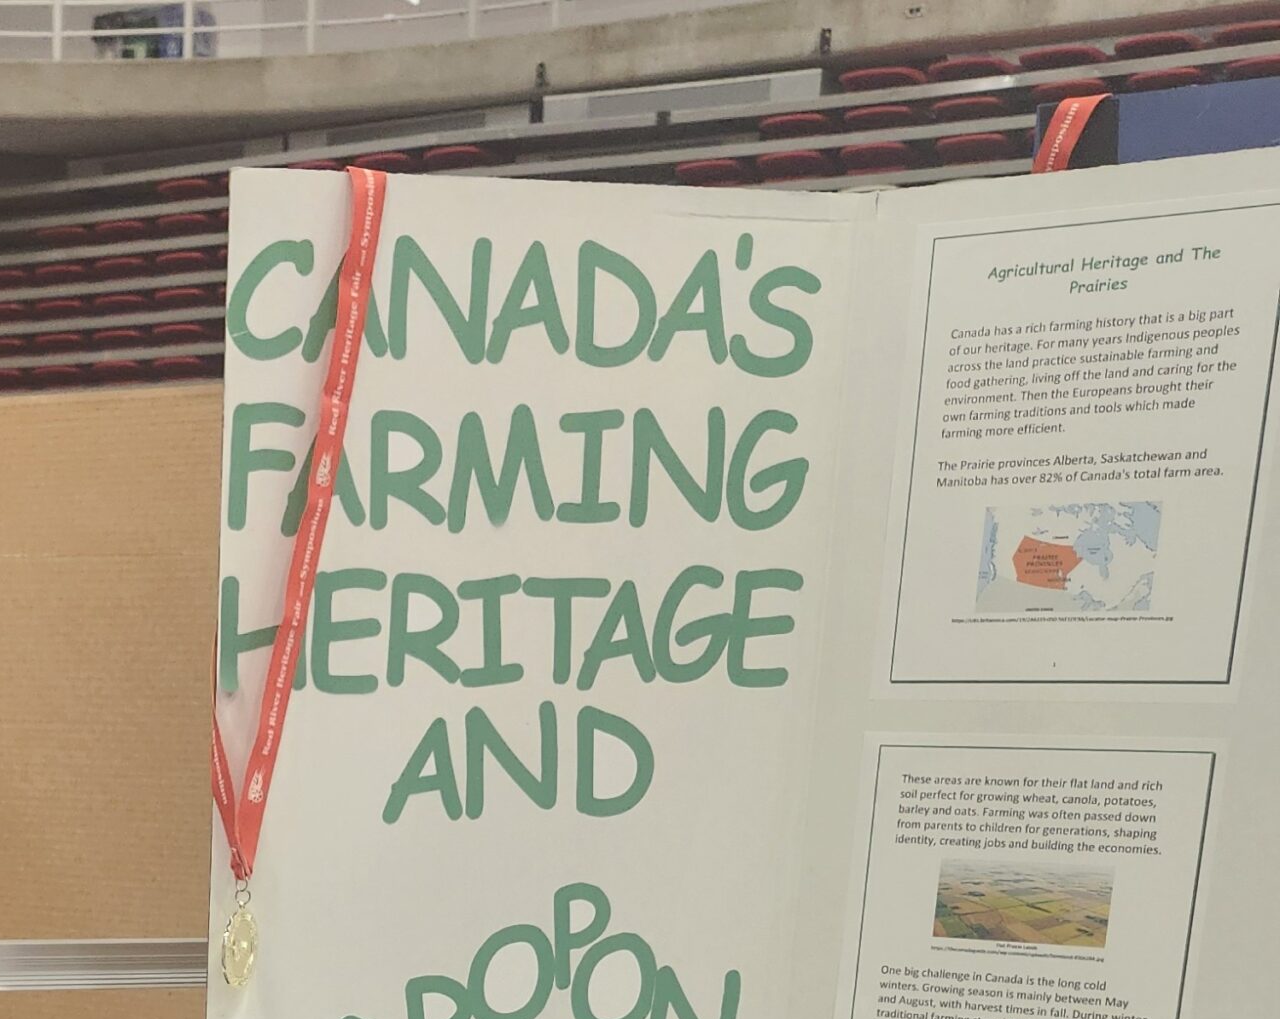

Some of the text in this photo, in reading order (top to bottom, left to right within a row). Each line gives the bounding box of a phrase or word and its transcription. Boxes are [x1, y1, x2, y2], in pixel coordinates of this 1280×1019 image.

[1044, 102, 1080, 172] ymposium
[987, 244, 1223, 282] Agricultural Heritage and The
[351, 271, 362, 298] Fair
[1069, 278, 1128, 294] Prairies
[226, 232, 821, 377] CANADA'S
[341, 301, 358, 364] Heritage
[332, 368, 347, 404] River
[944, 378, 1214, 406] environment. Then the Europeans brought their
[328, 406, 340, 436] Red
[227, 402, 809, 533] FARMING
[937, 447, 1208, 471] The Prairie provinces Alberta, Saskatchewan and
[220, 564, 803, 695] HERITAGE
[262, 729, 274, 755] Red
[269, 692, 281, 726] River
[276, 629, 295, 689] Heritage
[292, 600, 302, 627] Fair
[300, 498, 323, 580] Symposium
[382, 699, 655, 824] AND
[900, 789, 1157, 809] soil perfect for growing wheat, canola, potatoes,
[894, 833, 1162, 855] identity, creating jobs and building the economies.
